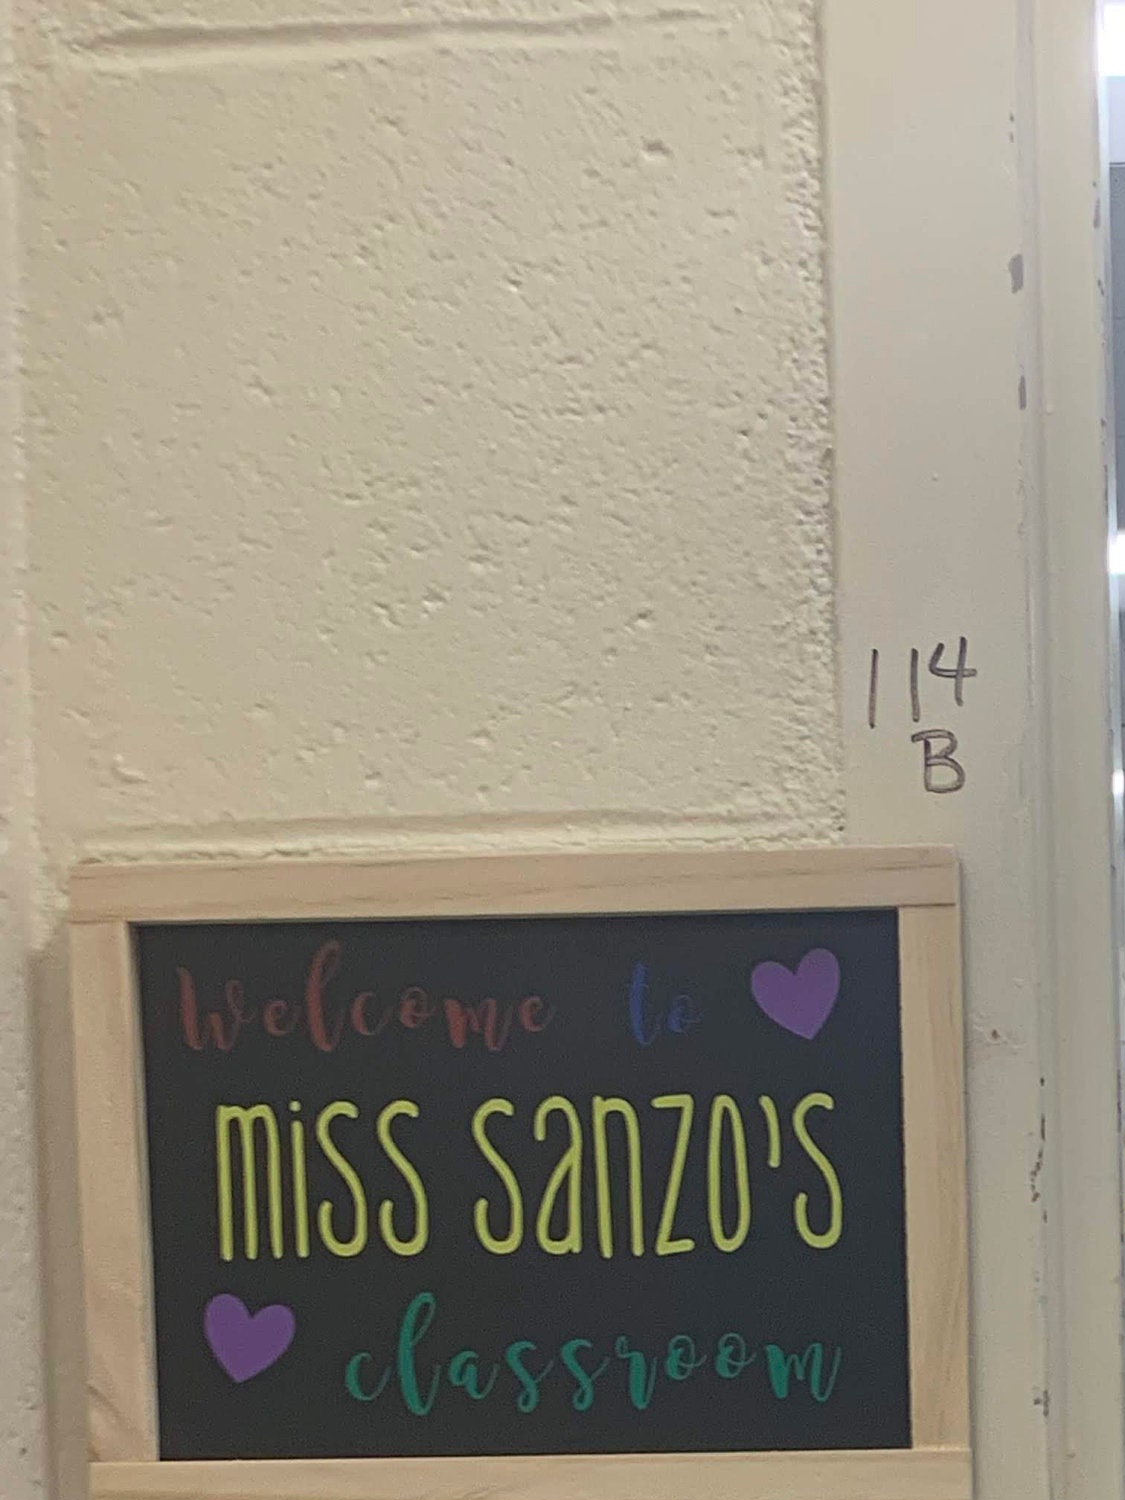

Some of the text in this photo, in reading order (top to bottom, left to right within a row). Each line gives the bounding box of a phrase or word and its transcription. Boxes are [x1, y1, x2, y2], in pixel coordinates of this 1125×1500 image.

[868, 636, 978, 729] 114
[911, 729, 966, 794] B
[627, 963, 702, 1047] to
[345, 1292, 844, 1417] classroom
